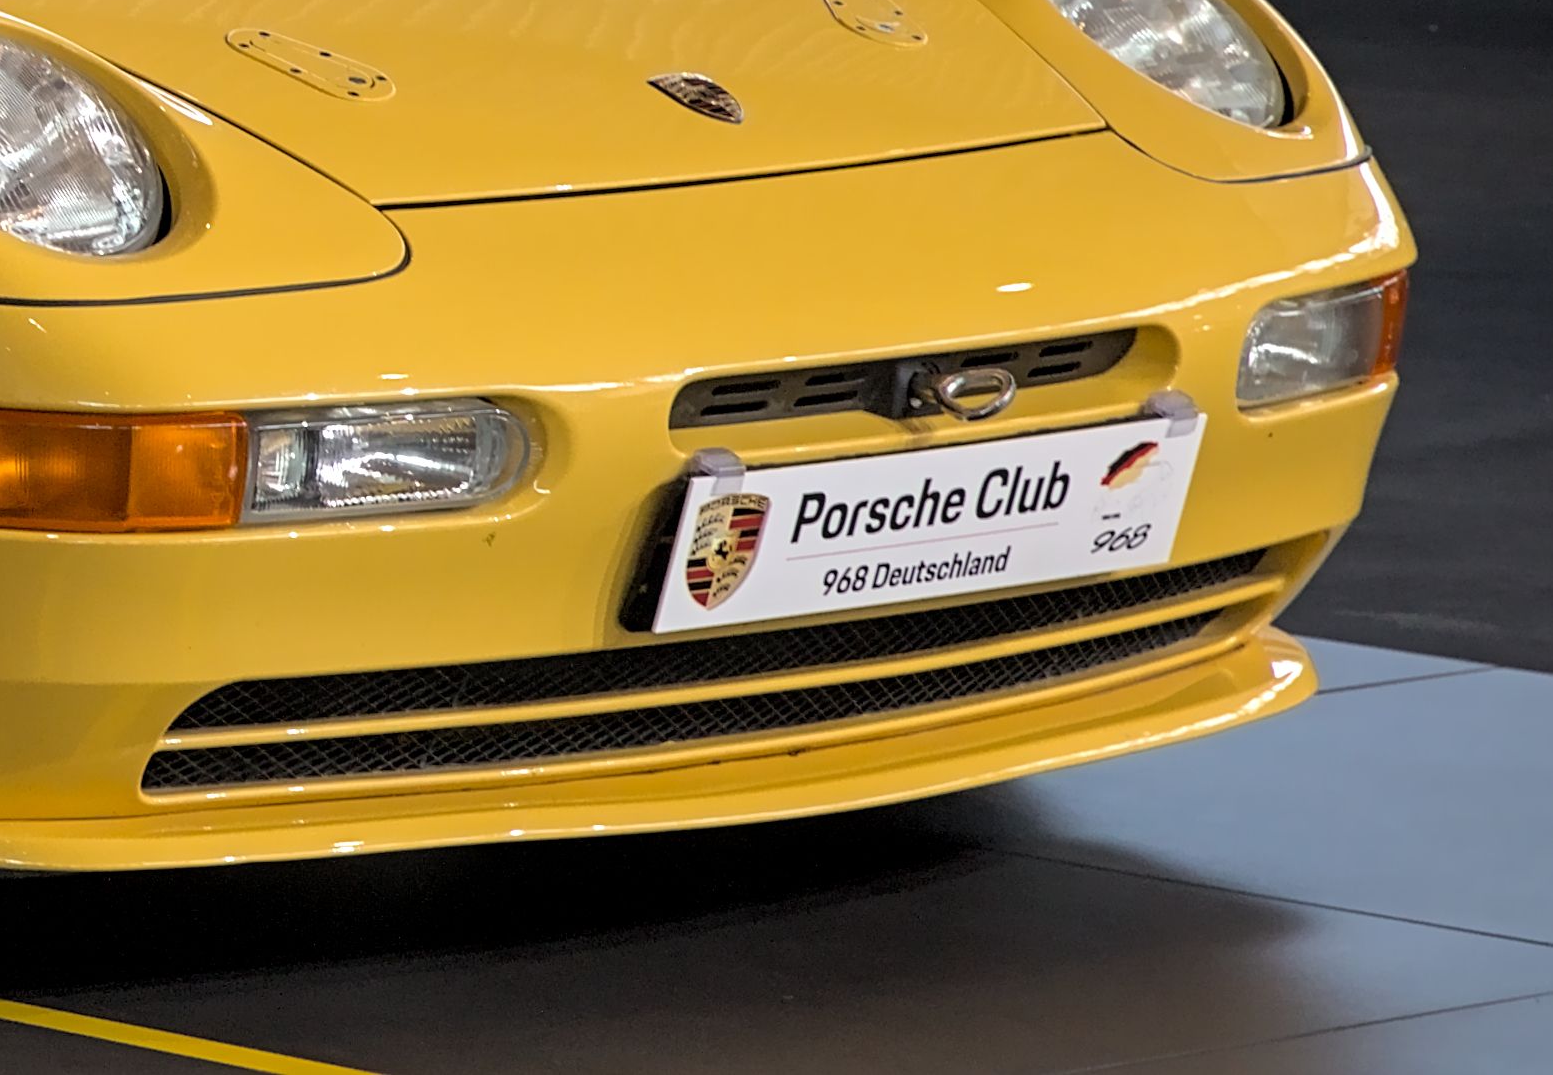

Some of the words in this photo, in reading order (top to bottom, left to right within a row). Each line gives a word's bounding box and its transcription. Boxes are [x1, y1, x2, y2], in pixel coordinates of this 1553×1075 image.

[790, 478, 968, 545] Porsche
[974, 459, 1072, 521] Club
[1090, 523, 1152, 554] 968
[822, 565, 869, 596] 968
[871, 546, 1011, 591] Deutschland
